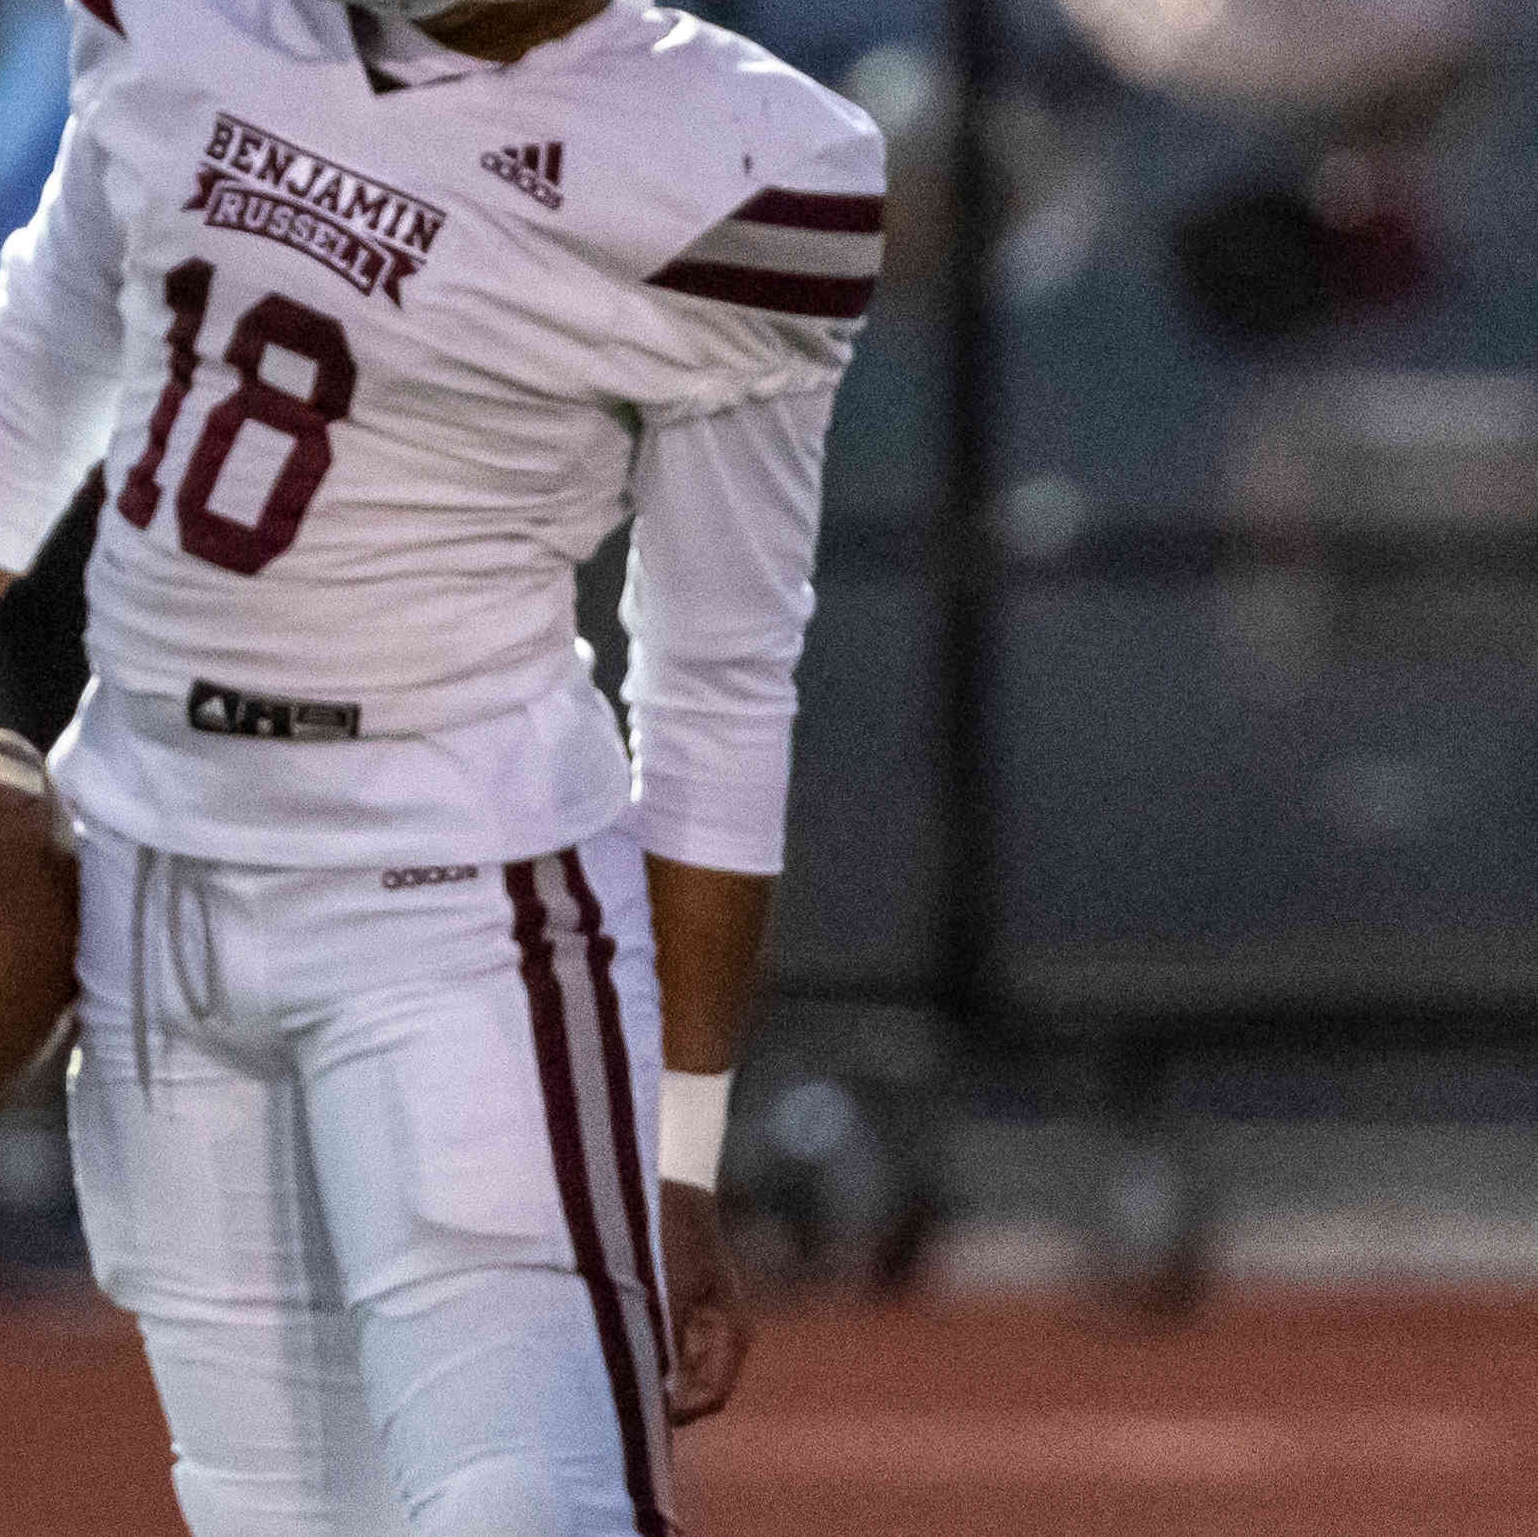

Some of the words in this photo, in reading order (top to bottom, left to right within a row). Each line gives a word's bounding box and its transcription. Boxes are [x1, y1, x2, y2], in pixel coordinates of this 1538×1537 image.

[205, 119, 445, 253] BENJAMIN
[212, 190, 373, 288] RUSSELL
[117, 256, 358, 577] 18
